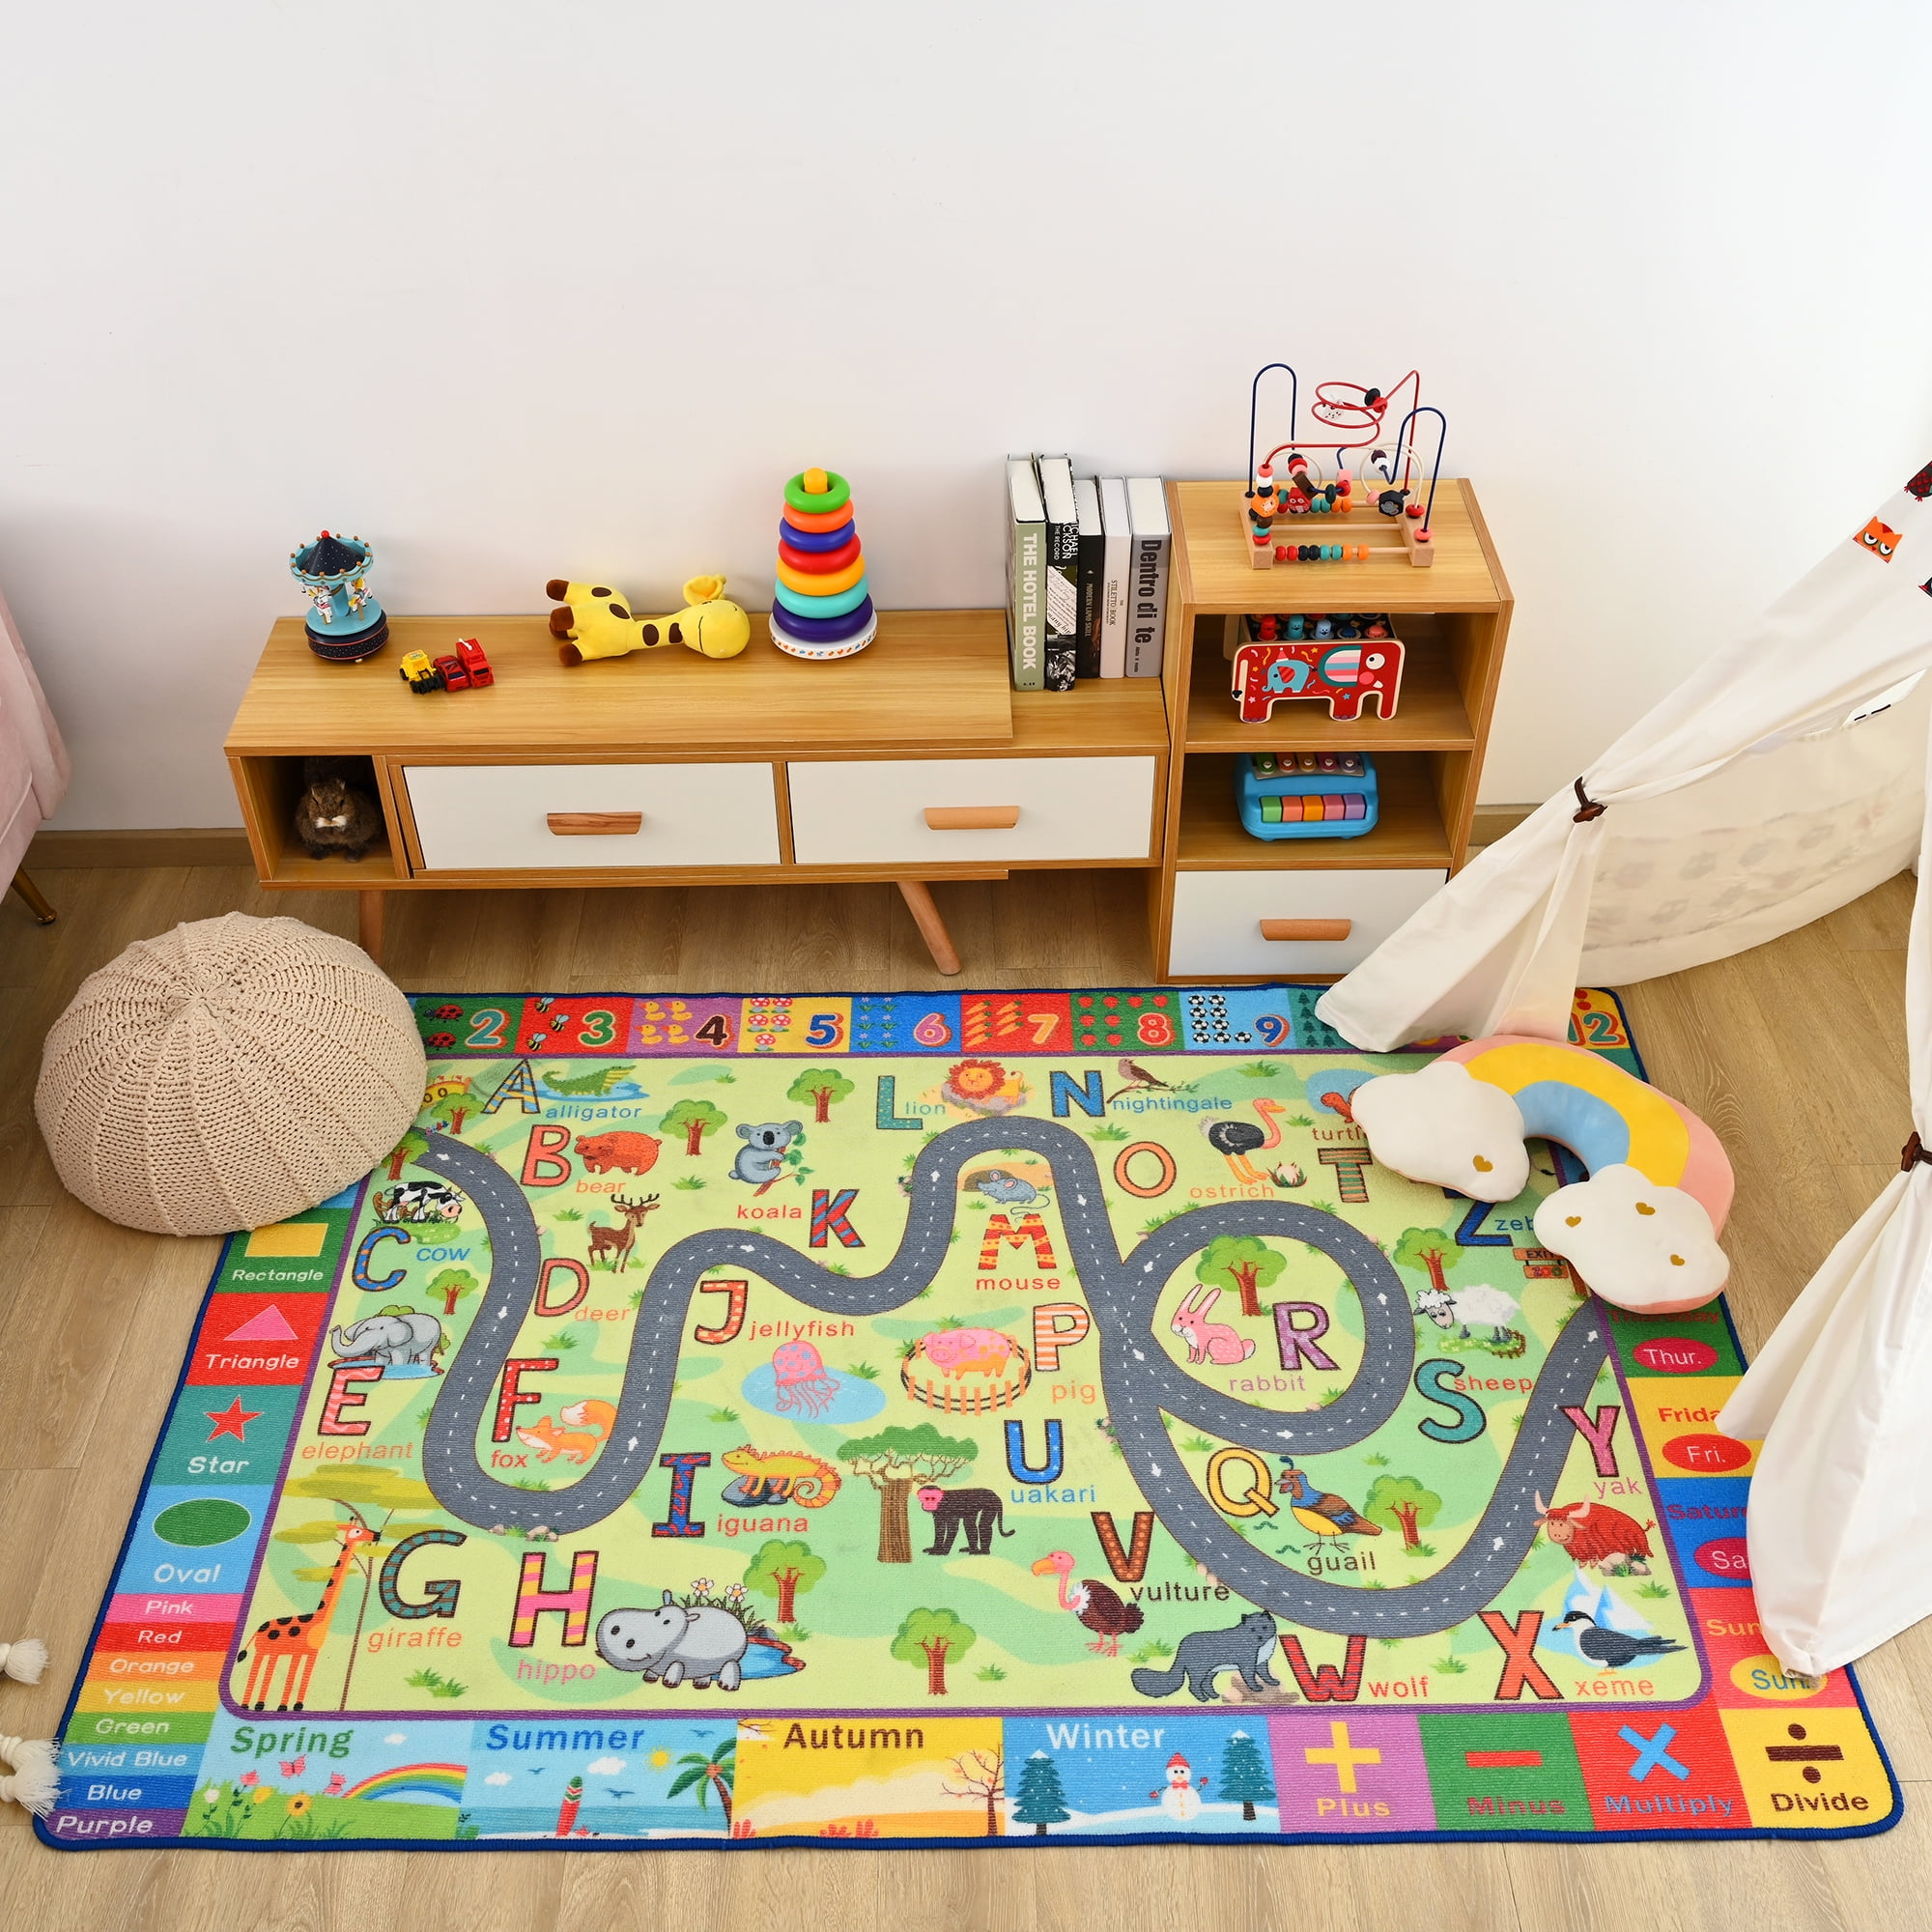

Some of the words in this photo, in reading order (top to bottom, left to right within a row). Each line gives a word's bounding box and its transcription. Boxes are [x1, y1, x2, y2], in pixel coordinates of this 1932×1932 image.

[1024, 533, 1037, 566] THE
[1063, 522, 1071, 559] CKSON
[1069, 523, 1078, 555] ICHAEL
[1138, 540, 1162, 597] Dentro
[1024, 570, 1037, 622] HOTEL
[1137, 603, 1157, 618] di
[1135, 627, 1155, 643] te
[1023, 626, 1037, 669] BOOK
[465, 1008, 511, 1049] 2
[579, 1010, 619, 1047] 3
[695, 1014, 735, 1050] 4
[805, 1012, 845, 1050] 5
[913, 1011, 952, 1048] 6
[1026, 1013, 1060, 1045] 7
[1137, 1012, 1177, 1047] 8
[1253, 1013, 1290, 1047] 9
[480, 1059, 541, 1115] A
[1050, 1070, 1105, 1118] N
[545, 1105, 642, 1122] alligator
[876, 1075, 923, 1130] L
[905, 1101, 946, 1115] lion
[1113, 1096, 1233, 1113] nightingale
[1312, 1124, 1368, 1141] turtl
[520, 1124, 572, 1187] B
[1113, 1141, 1177, 1198] O
[1317, 1148, 1373, 1203] T
[576, 1179, 626, 1194] bear
[1189, 1184, 1274, 1199] ostrich
[737, 1205, 802, 1220] koala
[809, 1188, 866, 1248] K
[1494, 1215, 1534, 1232] zeb
[978, 1213, 1057, 1270] M
[352, 1226, 412, 1292] C
[416, 1247, 470, 1262] cow
[232, 1268, 324, 1284] Rectangle
[534, 1258, 590, 1317] D
[976, 1277, 1061, 1291] mouse
[574, 1306, 630, 1321] deer
[695, 1280, 749, 1345] J
[749, 1320, 855, 1341] jellyfish
[1033, 1303, 1091, 1372] P
[1272, 1301, 1341, 1371] R
[205, 1353, 299, 1371] Triangle
[1643, 1349, 1702, 1365] Thur.
[1051, 1381, 1096, 1406] pig
[1230, 1376, 1306, 1393] rabbit
[1454, 1376, 1533, 1393] sheep
[317, 1365, 385, 1436] E
[492, 1357, 559, 1442] F
[1414, 1357, 1487, 1444] S
[1658, 1406, 1721, 1423] Frida
[301, 1442, 413, 1463] elephant
[1004, 1418, 1065, 1485] U
[1558, 1405, 1621, 1478] Y
[187, 1456, 249, 1474] Star
[491, 1449, 528, 1469] fox
[1687, 1445, 1726, 1463] Fri.
[651, 1451, 712, 1538] I
[1010, 1485, 1096, 1503] uakari
[1207, 1447, 1280, 1519] Q
[1593, 1477, 1643, 1498] yak
[1667, 1504, 1747, 1520] Satur
[718, 1514, 809, 1537] iguana
[1090, 1511, 1155, 1582] V
[1308, 1551, 1377, 1575] guail
[1712, 1550, 1747, 1570] Sa
[154, 1563, 221, 1583] Oval
[379, 1529, 468, 1620] G
[508, 1550, 599, 1648] H
[1130, 1581, 1231, 1603] vulture
[146, 1600, 193, 1615] Pink
[138, 1630, 183, 1644] Red
[1706, 1618, 1762, 1636] Sun
[367, 1627, 463, 1654] giraffe
[109, 1658, 195, 1675] Orange
[1477, 1609, 1565, 1700] X
[518, 1660, 596, 1684] hippo
[1278, 1634, 1368, 1702] W
[103, 1689, 185, 1705] Yellow
[1367, 1676, 1430, 1697] wolf
[1575, 1680, 1654, 1697] xeme
[95, 1719, 170, 1735] Green
[486, 1723, 645, 1750] Summer
[783, 1722, 924, 1749] Autumn
[1045, 1722, 1166, 1749] Winter
[230, 1725, 355, 1759] Spring
[68, 1750, 127, 1767] Vivid
[133, 1750, 188, 1767] Blue
[87, 1784, 142, 1802] Blue
[1770, 1792, 1870, 1813] Divide
[1316, 1797, 1391, 1818] Plus
[1467, 1796, 1566, 1816] Minus
[1604, 1793, 1734, 1819] Multiply
[56, 1815, 153, 1837] Purple
